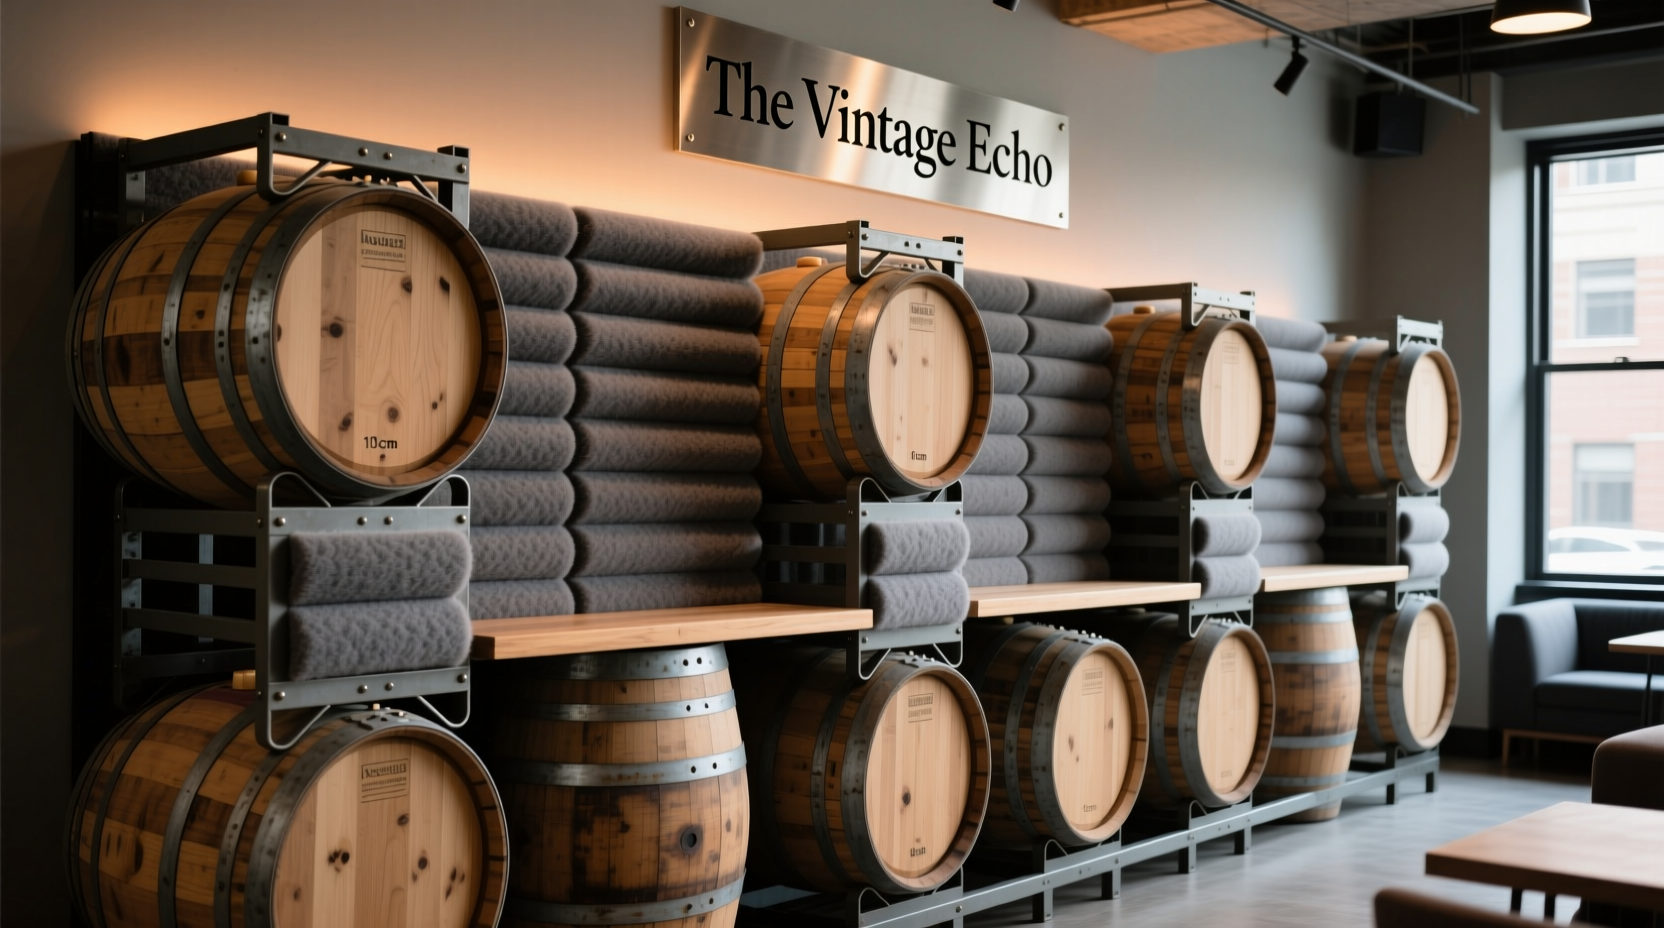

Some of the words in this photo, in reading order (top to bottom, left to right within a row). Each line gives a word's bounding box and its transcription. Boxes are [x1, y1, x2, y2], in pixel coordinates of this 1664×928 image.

[706, 55, 794, 130] The
[801, 77, 957, 179] Vintage
[966, 119, 1053, 188] Echo
[363, 436, 398, 449] 10cm
